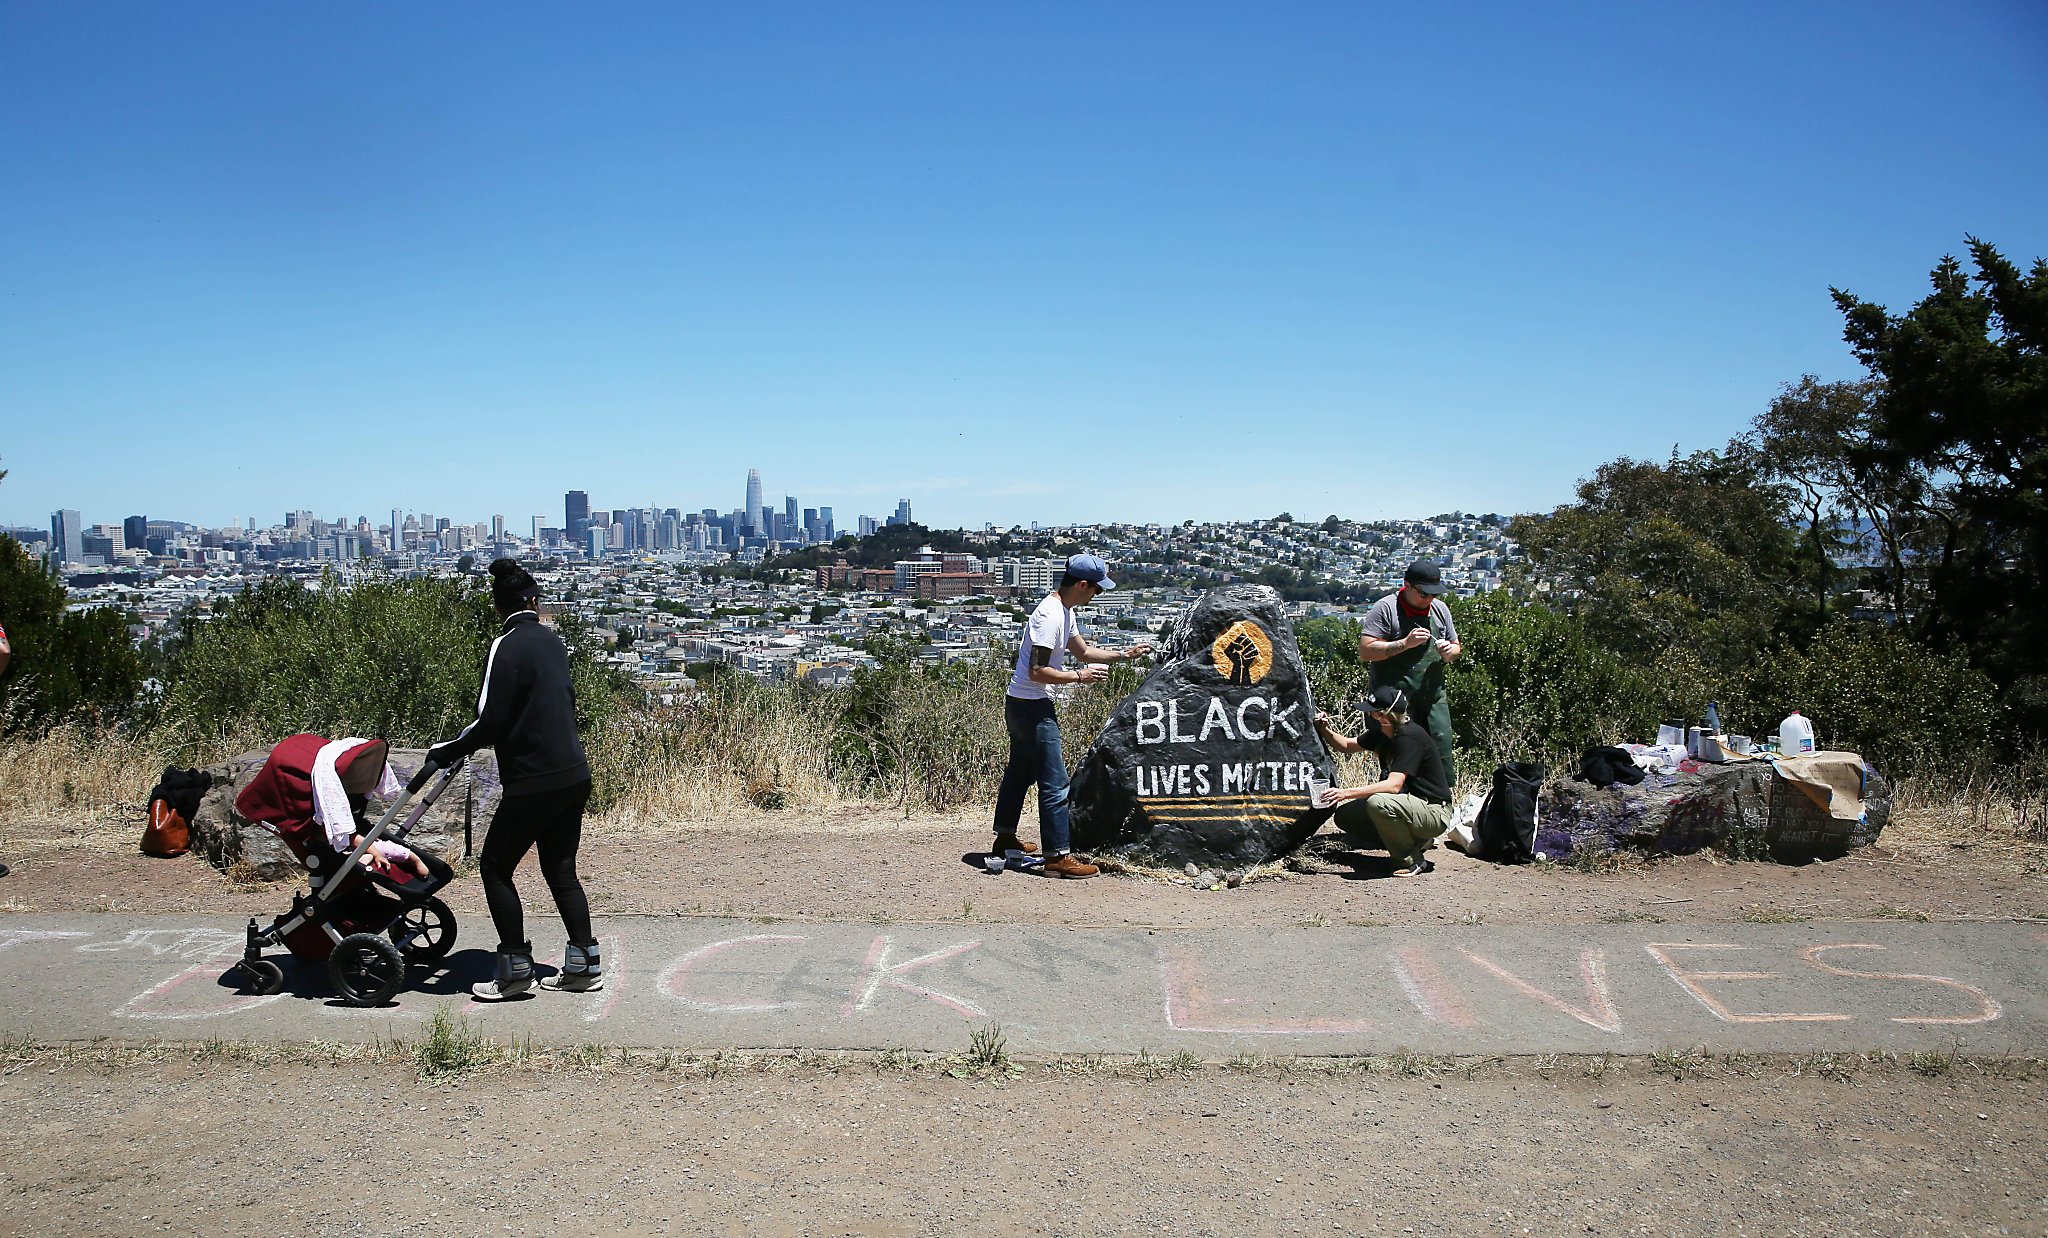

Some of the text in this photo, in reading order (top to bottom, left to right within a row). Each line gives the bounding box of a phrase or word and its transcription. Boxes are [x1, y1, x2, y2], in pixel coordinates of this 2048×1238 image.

[1135, 696, 1302, 745] BLACK
[1136, 764, 1211, 796] LIVES
[1778, 830, 1819, 844] AGAINST
[1158, 939, 2003, 1034] LIVES
